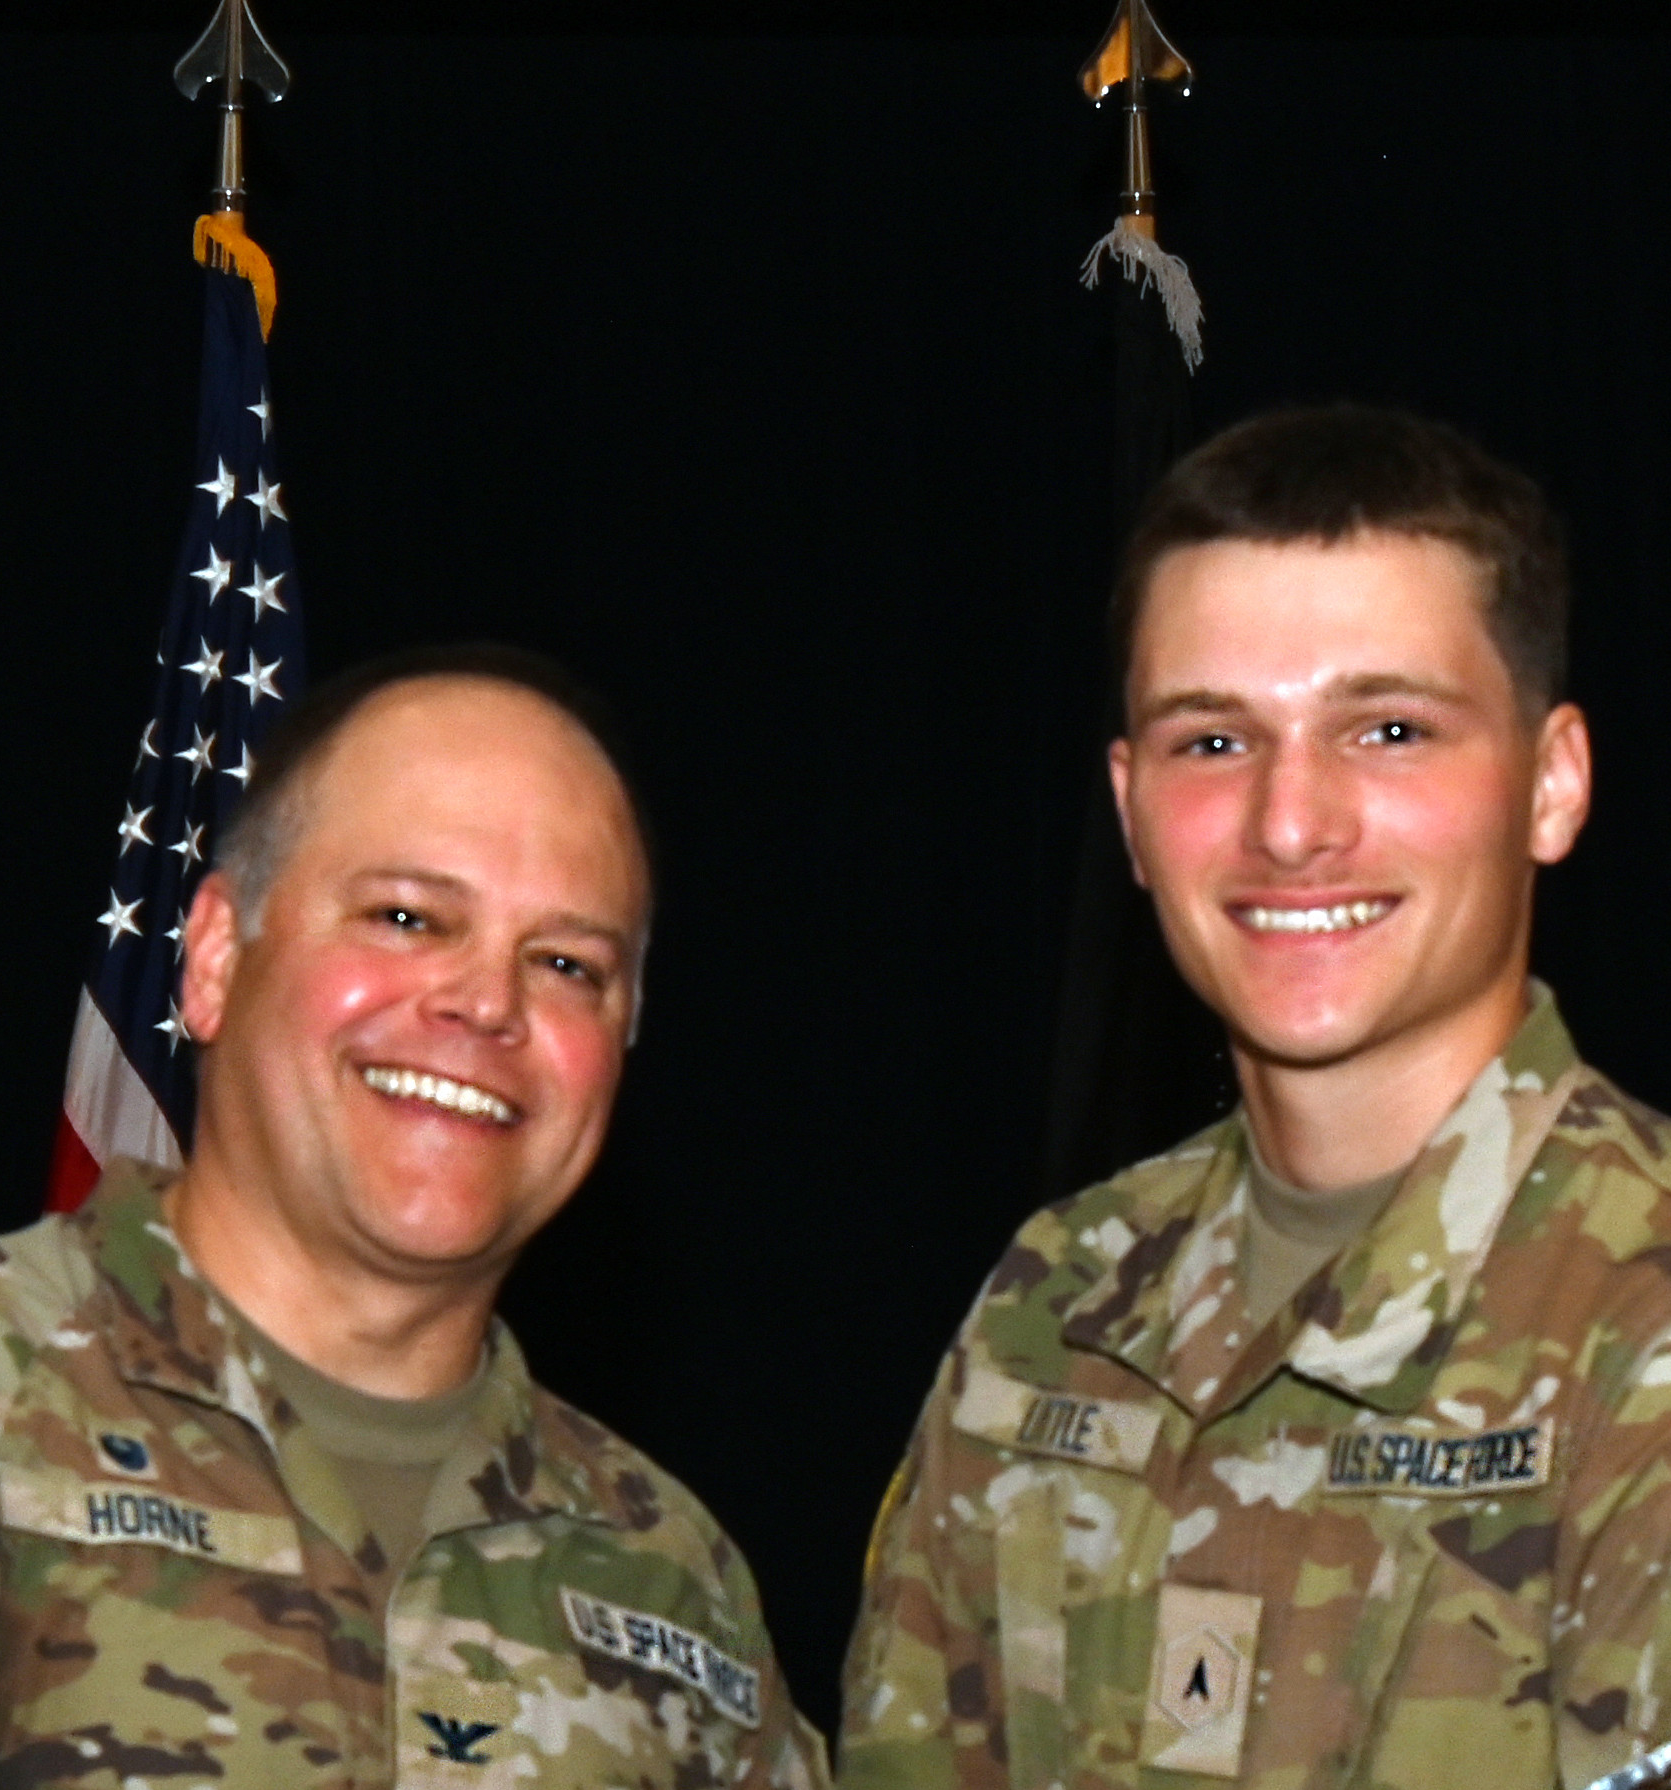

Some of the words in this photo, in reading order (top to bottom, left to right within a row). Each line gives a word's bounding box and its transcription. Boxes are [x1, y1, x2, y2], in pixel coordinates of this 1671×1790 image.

[1370, 1433, 1470, 1487] SPACE
[1467, 1425, 1538, 1481] FORCE
[87, 1493, 218, 1553] HORNE
